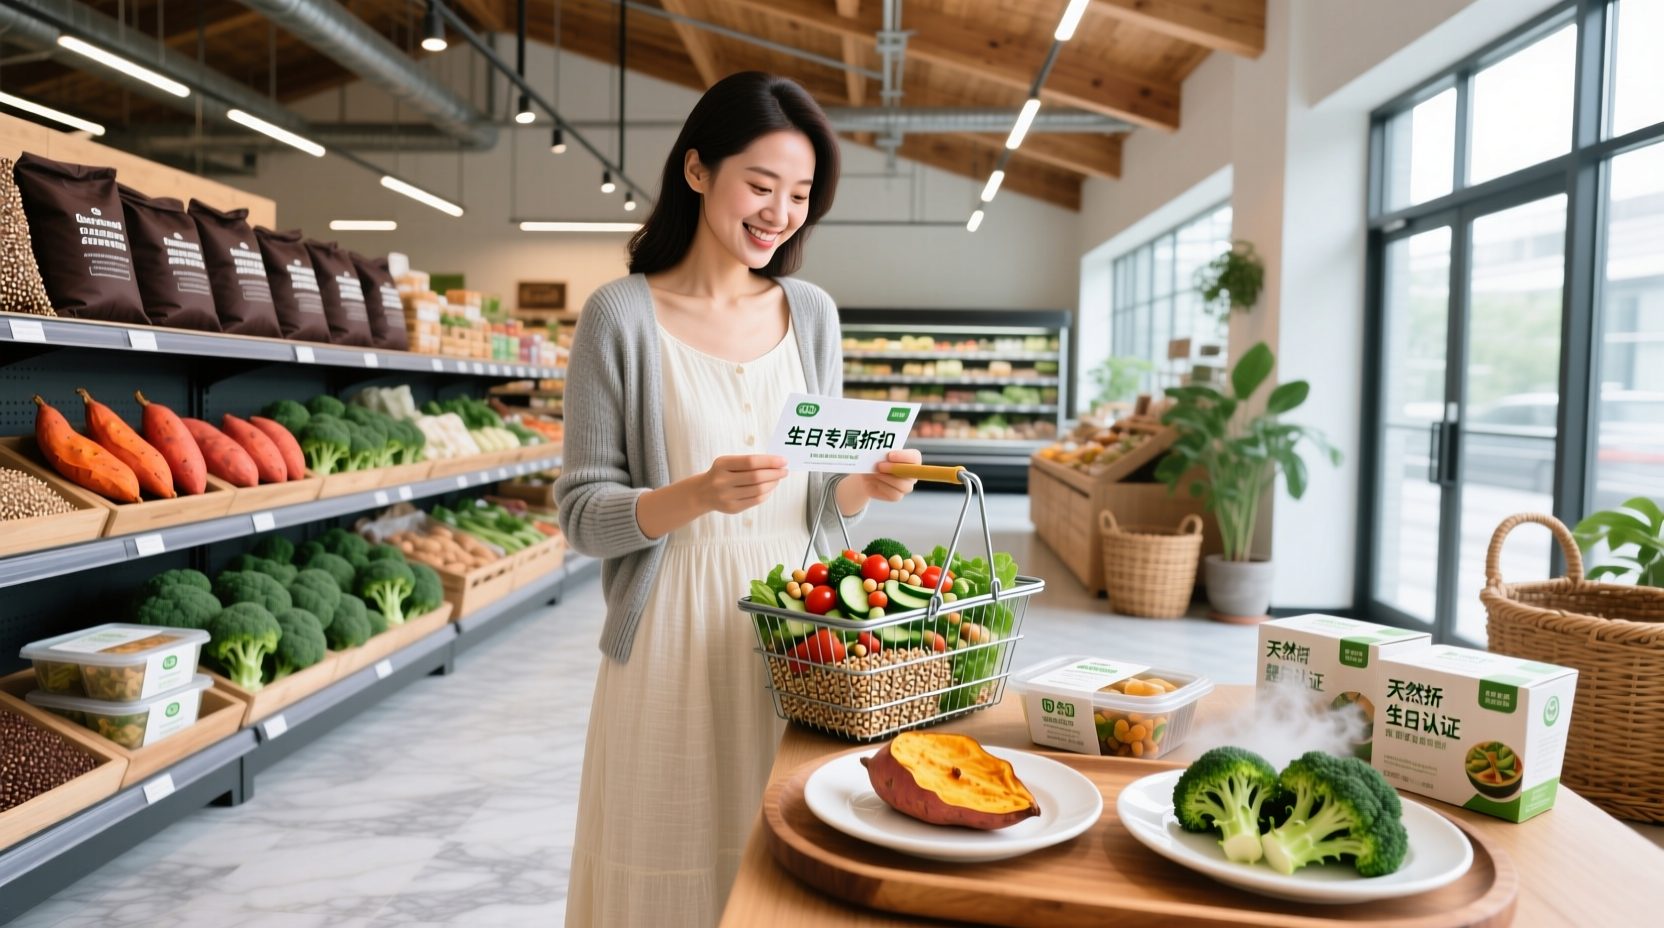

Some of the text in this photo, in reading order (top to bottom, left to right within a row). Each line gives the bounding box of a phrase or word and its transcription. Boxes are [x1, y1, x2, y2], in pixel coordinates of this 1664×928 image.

[785, 426, 896, 450] 生日专属折扣
[1386, 704, 1461, 740] 生日认证
